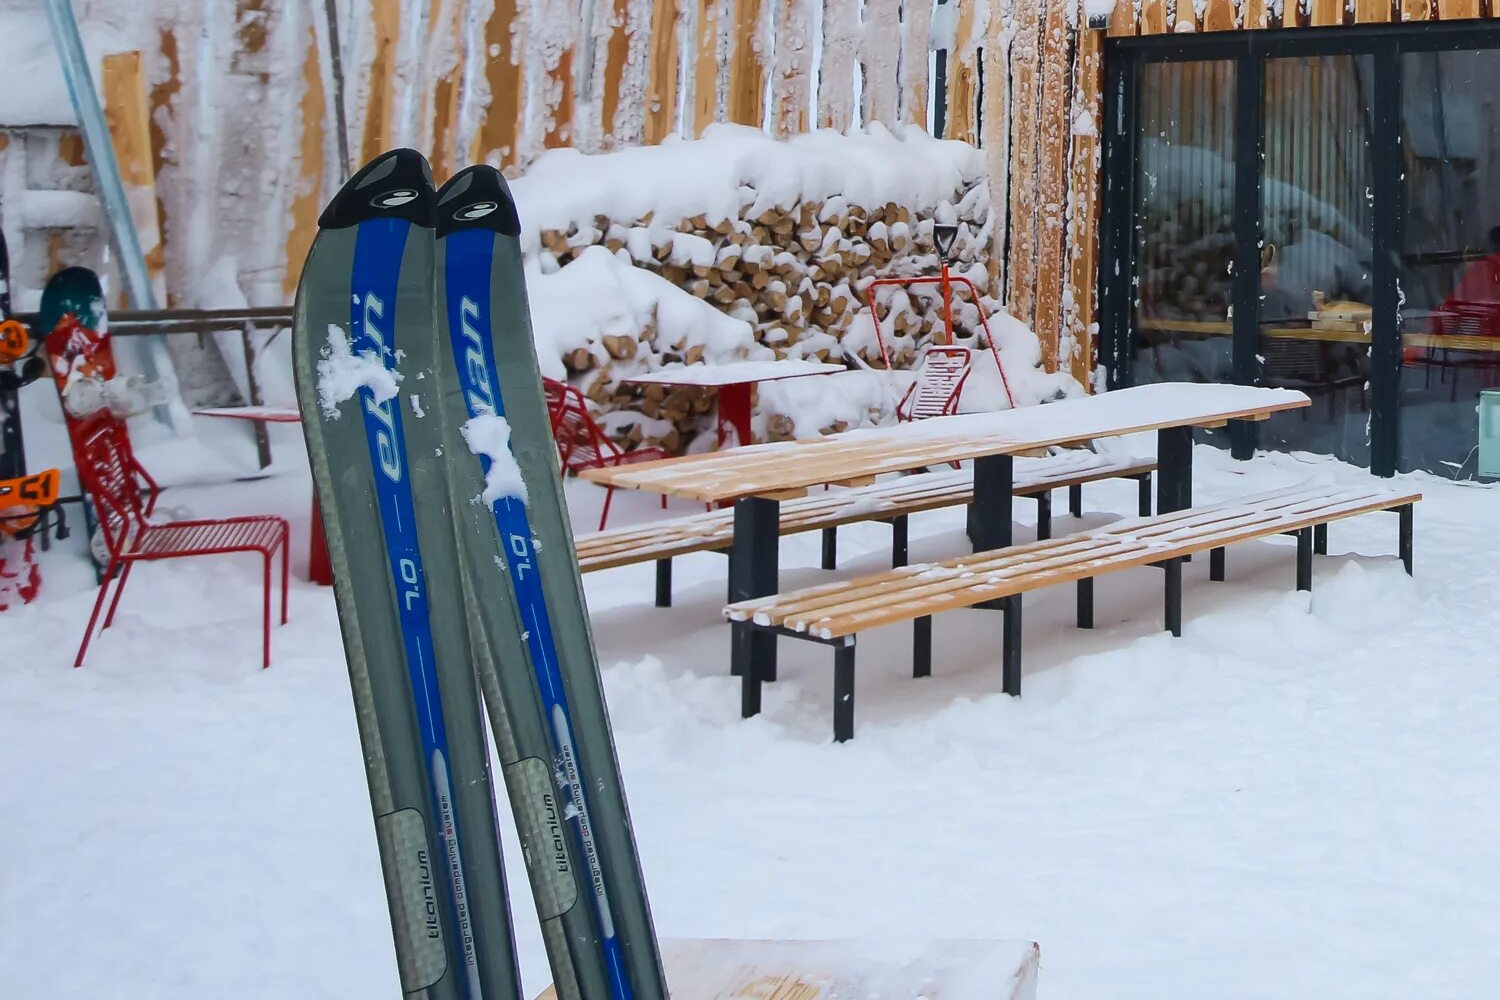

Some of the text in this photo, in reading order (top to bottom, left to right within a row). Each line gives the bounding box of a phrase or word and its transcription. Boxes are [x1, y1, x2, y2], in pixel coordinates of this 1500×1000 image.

[363, 291, 402, 483] eln
[417, 850, 440, 939] titanium
[439, 795, 475, 966] integrated dampening system
[543, 794, 569, 872] titanium
[561, 744, 604, 896] integrated dampening system
